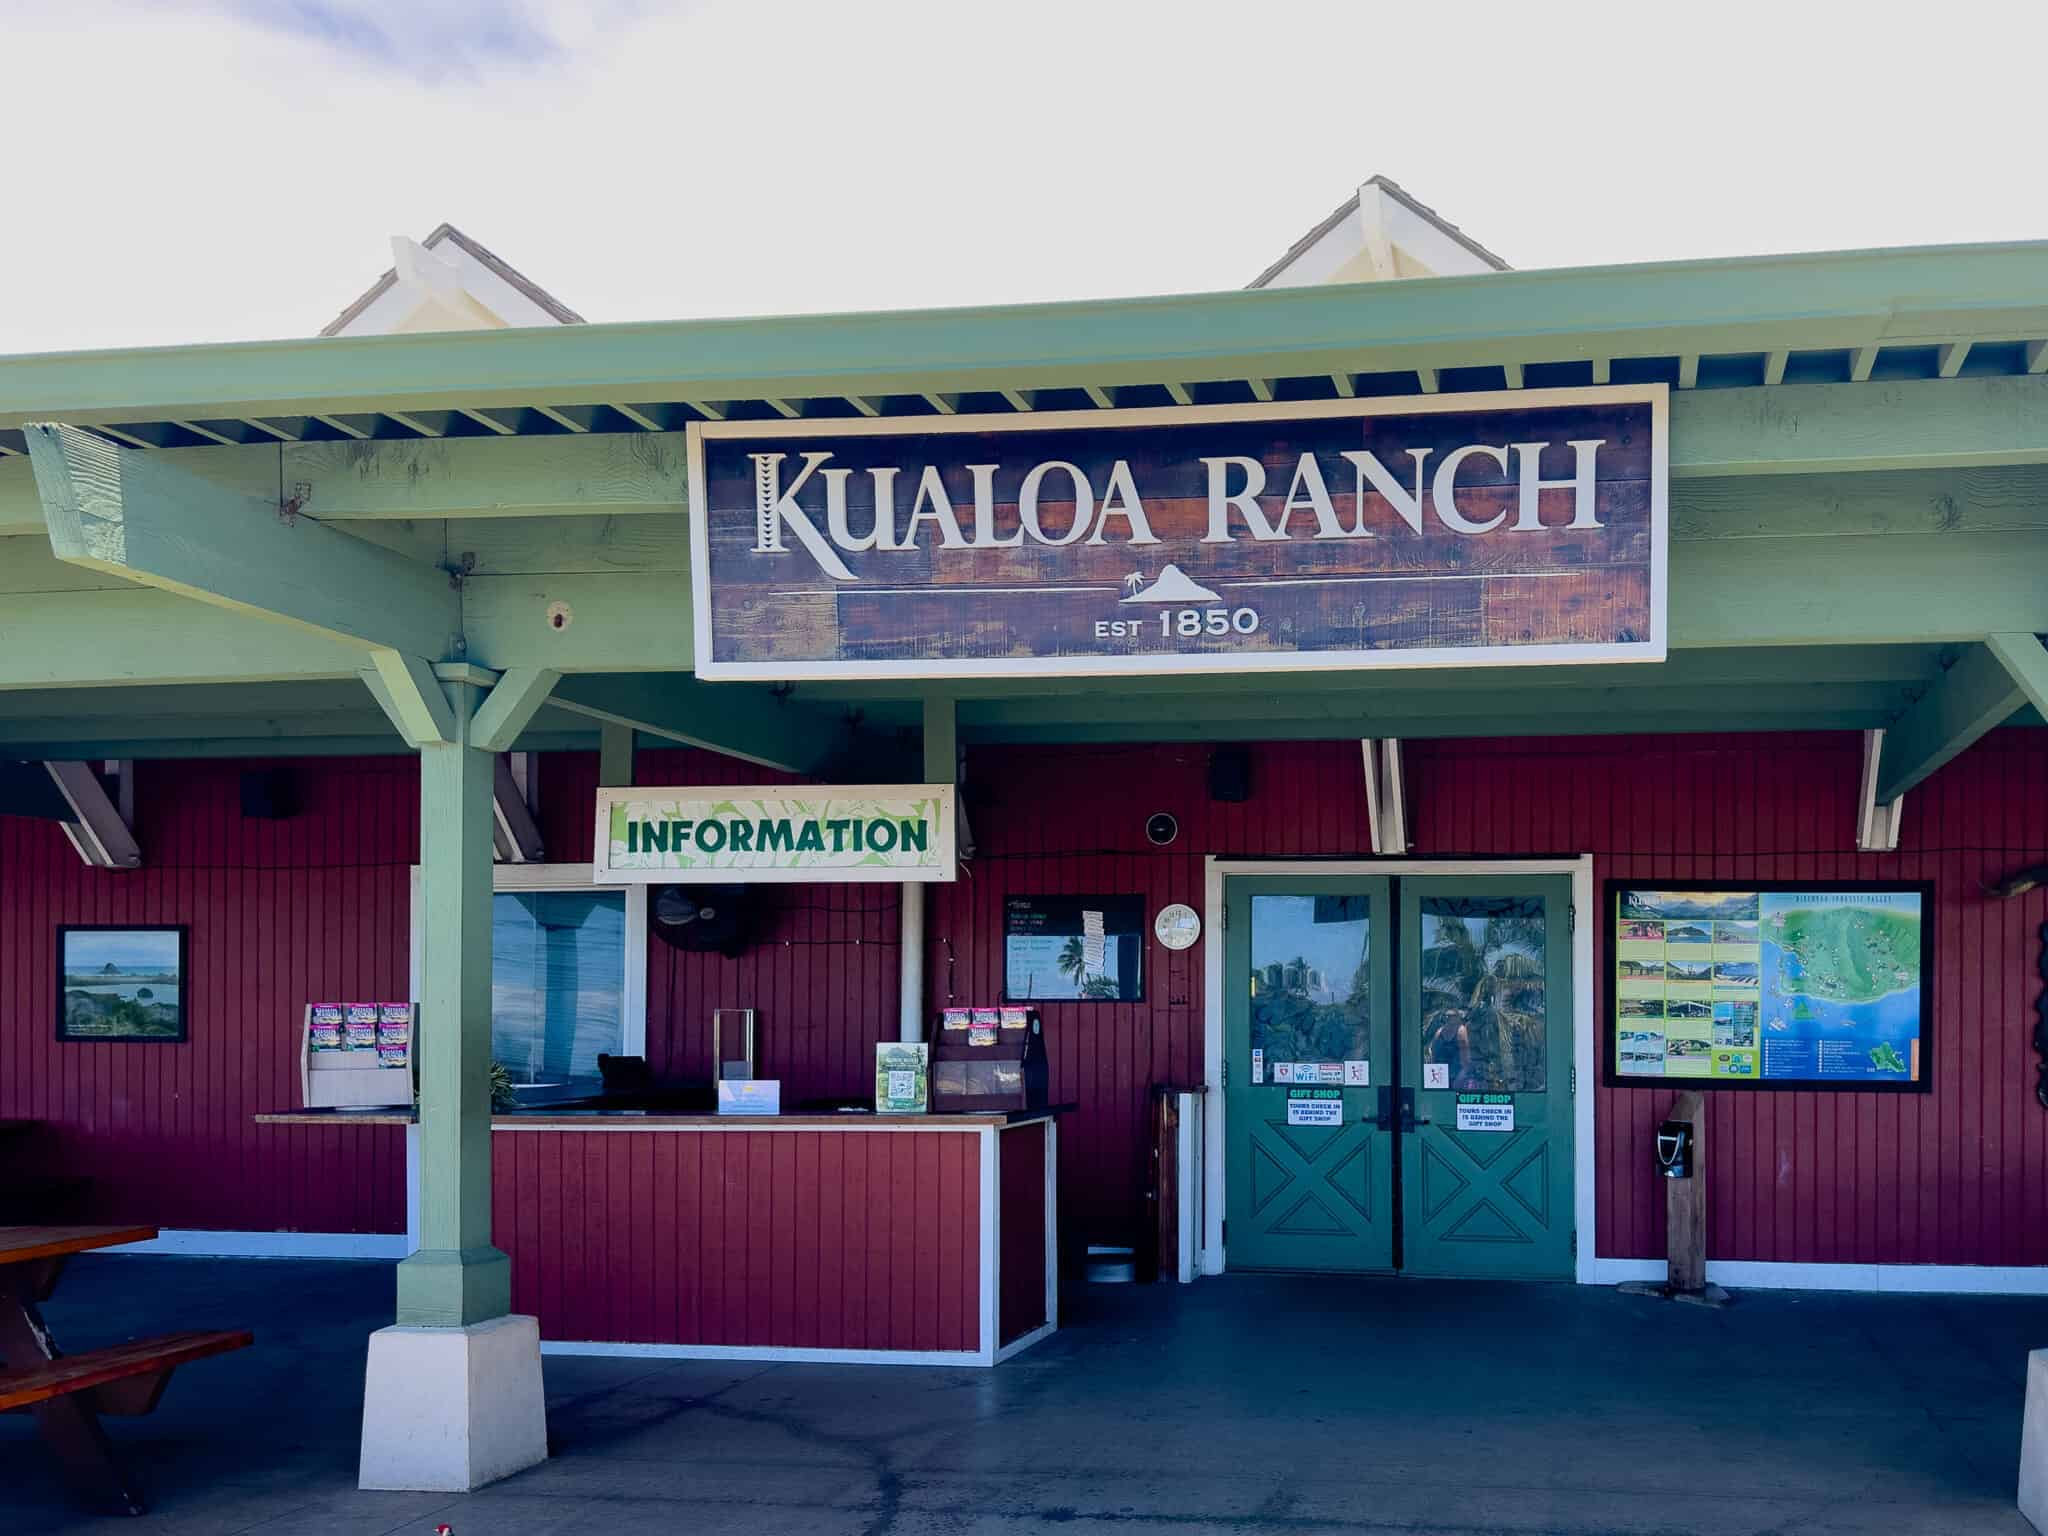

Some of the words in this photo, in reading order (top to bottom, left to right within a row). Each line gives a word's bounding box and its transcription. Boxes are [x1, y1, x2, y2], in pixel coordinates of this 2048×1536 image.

[747, 452, 1162, 581] KUALOA
[1199, 439, 1606, 544] RANCH
[1095, 620, 1143, 638] EST
[1159, 607, 1259, 637] 1850
[627, 818, 928, 852] INFORMATION
[1290, 1089, 1312, 1098] GIFT
[1313, 1089, 1341, 1099] SHOP
[1459, 1094, 1481, 1103] GIFT
[1483, 1094, 1512, 1104] SHOP
